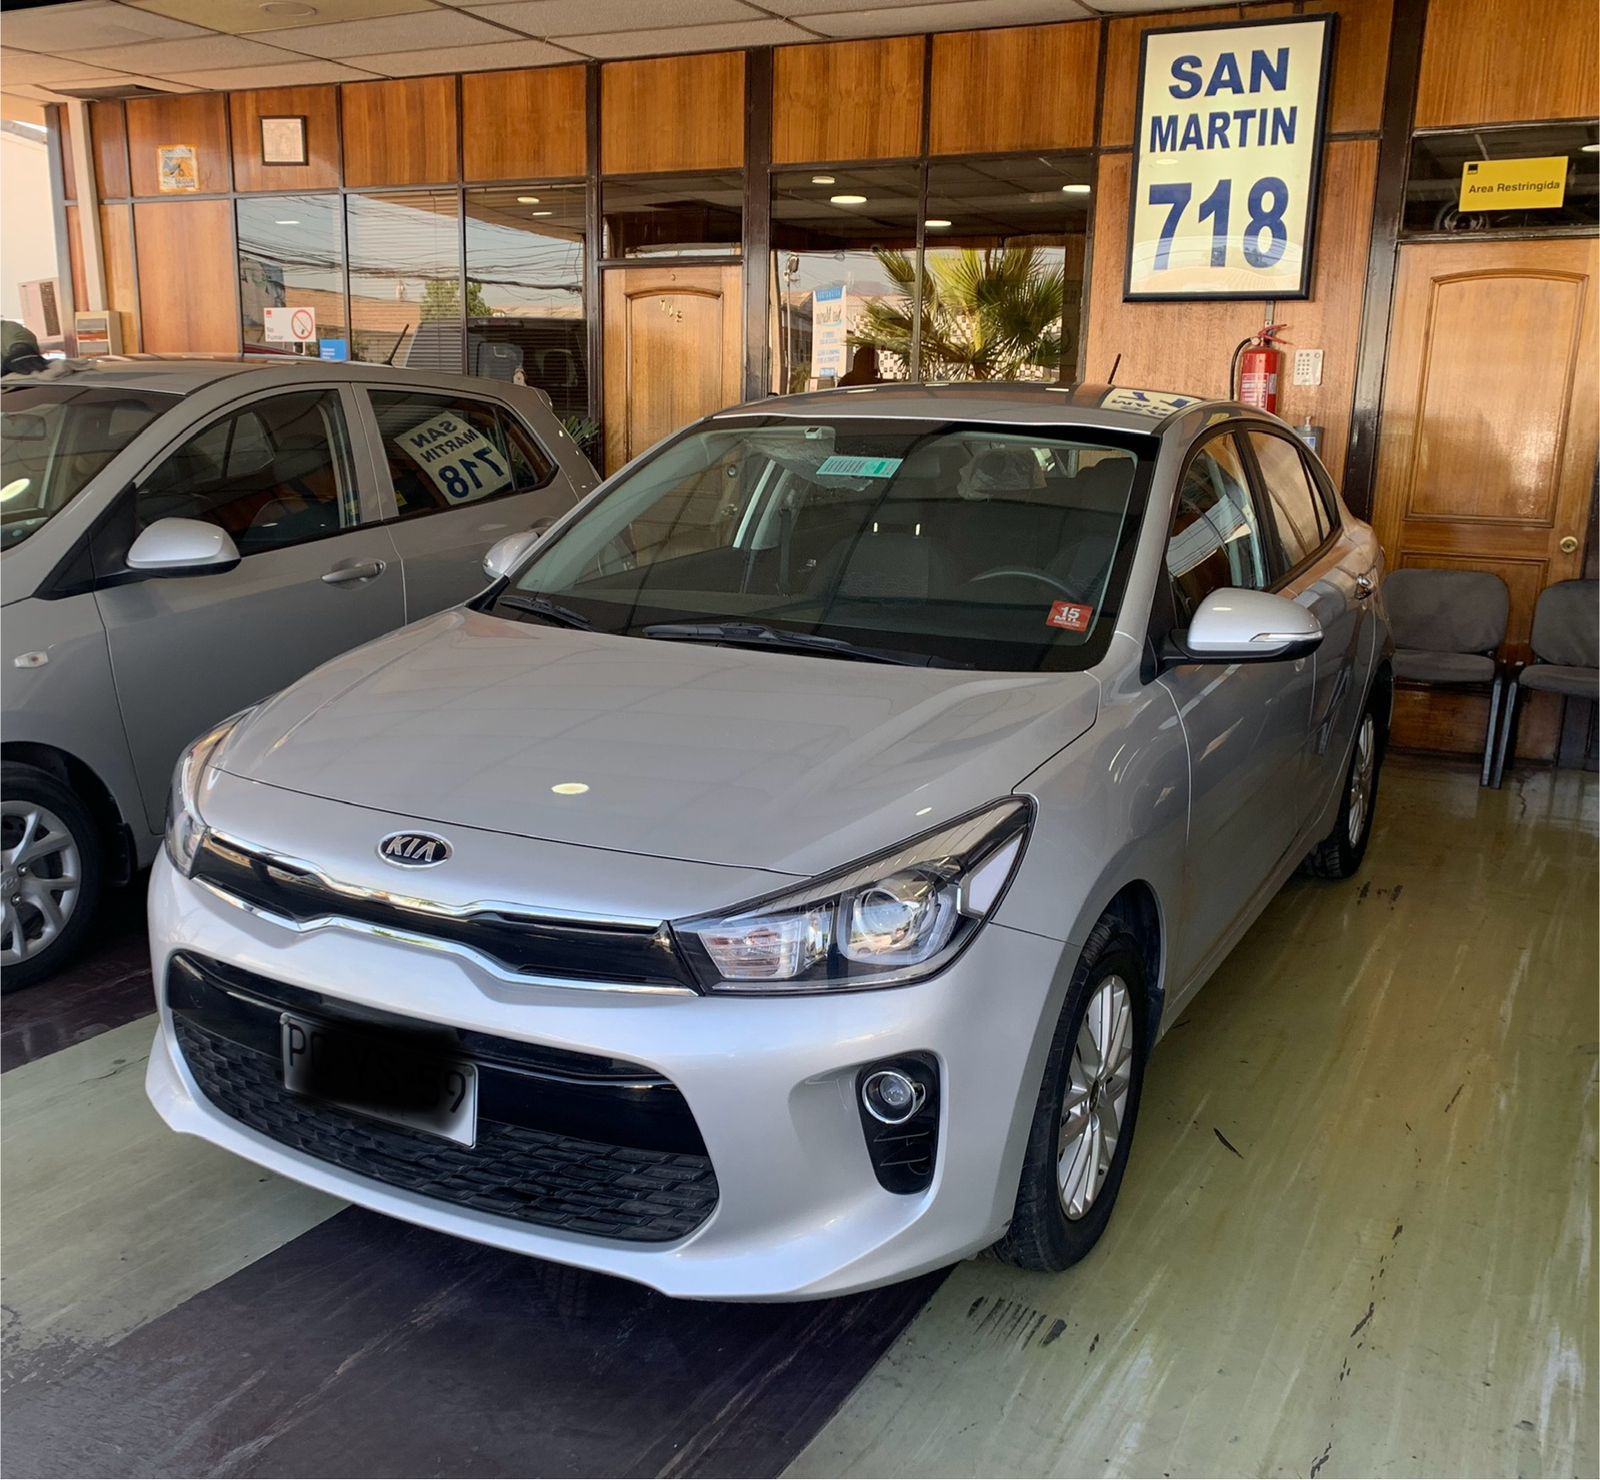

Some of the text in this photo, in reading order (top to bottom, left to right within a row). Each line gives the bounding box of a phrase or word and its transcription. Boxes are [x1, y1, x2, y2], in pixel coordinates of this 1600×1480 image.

[1168, 47, 1290, 100] SAN
[1149, 106, 1298, 153] MARTIN
[1468, 180, 1560, 194] Area Restringida
[1148, 176, 1289, 271] 718
[1061, 606, 1081, 619] 15
[385, 836, 437, 863] KIA
